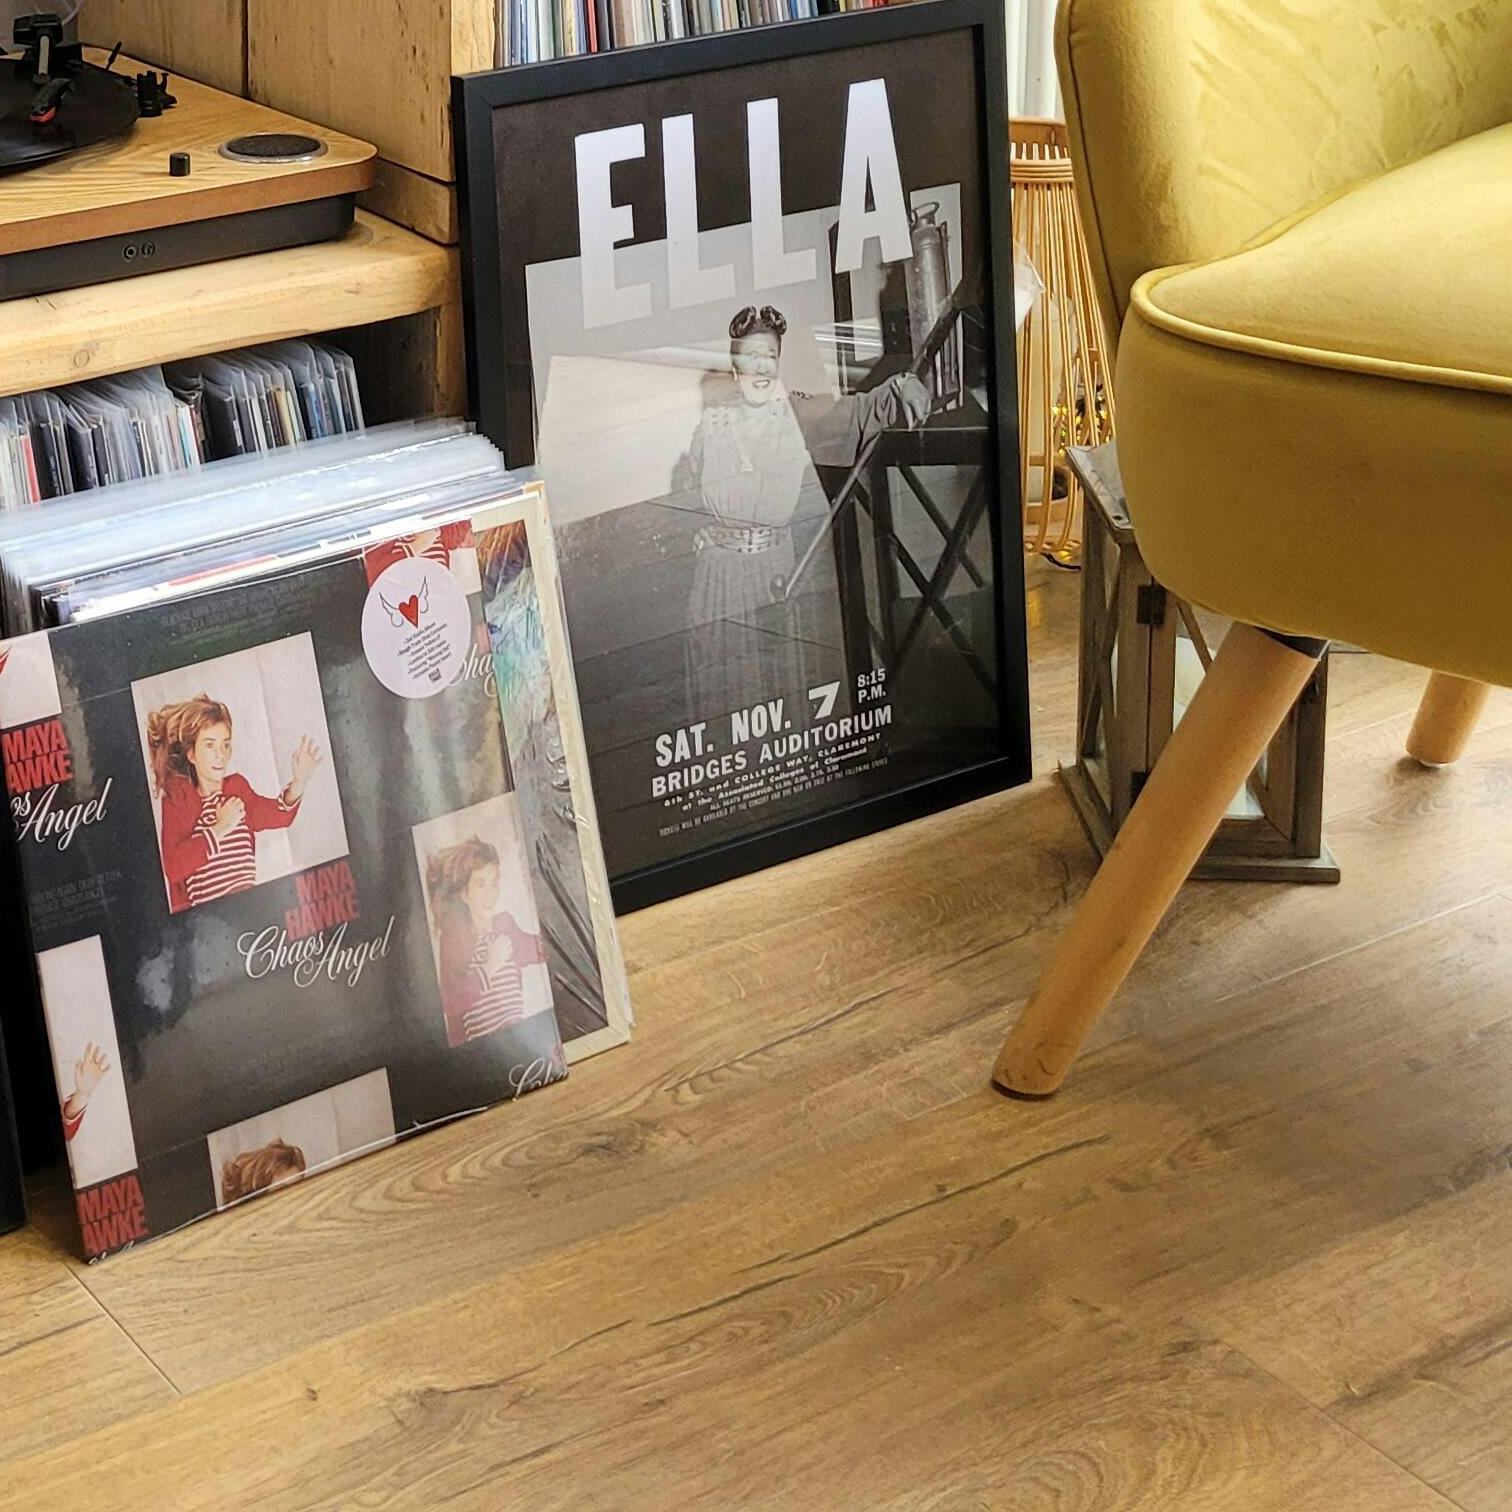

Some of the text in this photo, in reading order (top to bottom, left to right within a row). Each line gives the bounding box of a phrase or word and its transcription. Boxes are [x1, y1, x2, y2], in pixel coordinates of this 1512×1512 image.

[574, 77, 914, 329] ELLA
[857, 668, 887, 688] 8:15
[858, 686, 887, 704] P.M.
[0, 717, 68, 765] MAYA
[655, 680, 841, 768] SAT. NOV. 7
[652, 704, 893, 798] BRIDGES AUDITORIUM
[709, 781, 729, 794] and
[734, 764, 781, 785] COLLEGE
[817, 732, 881, 759] CLAREMONT
[697, 795, 714, 807] the
[718, 779, 765, 800] Associated
[769, 767, 805, 785] Colleges
[16, 777, 113, 852] Angel
[295, 859, 357, 904] MAYA
[285, 890, 361, 941] HAWKE
[237, 915, 395, 988] Chaos Angel
[76, 1173, 145, 1225] MAYA
